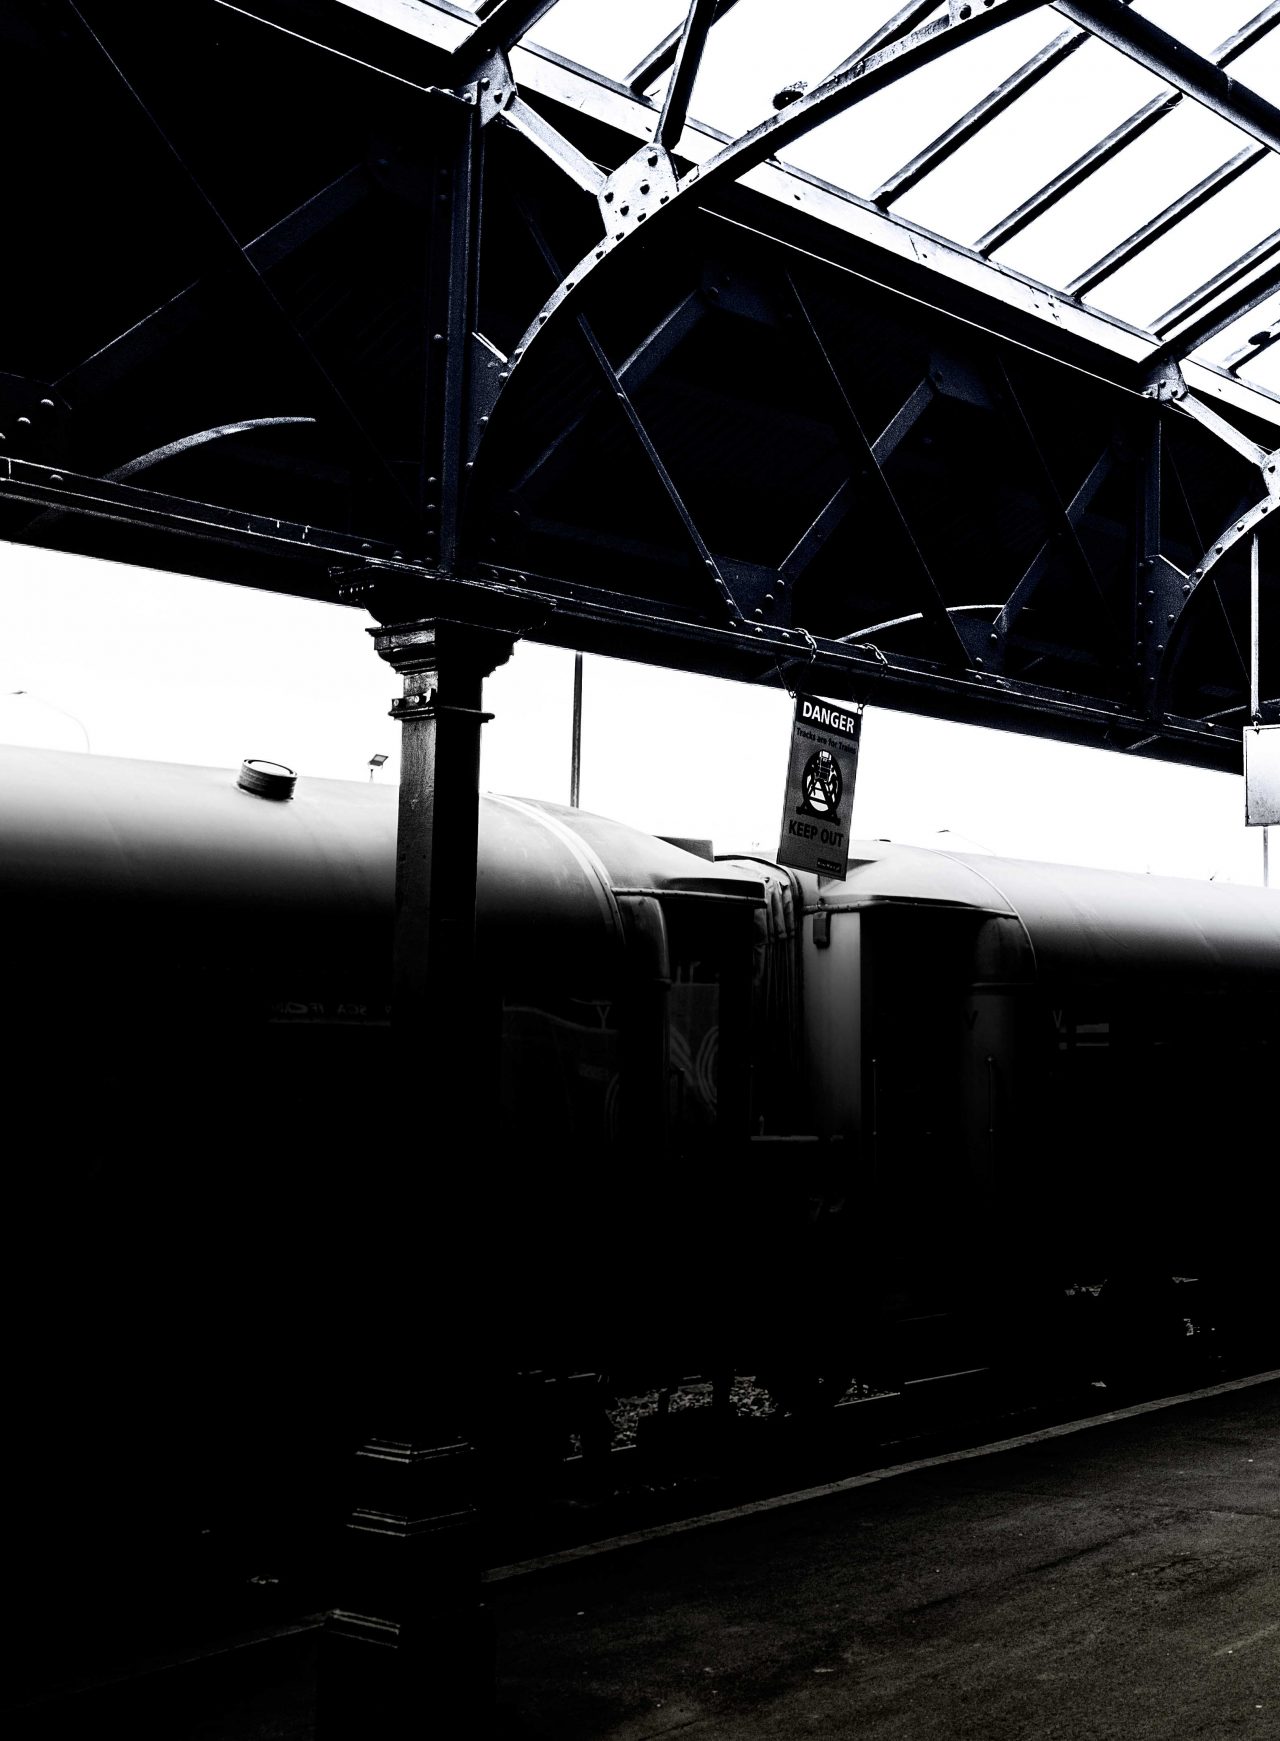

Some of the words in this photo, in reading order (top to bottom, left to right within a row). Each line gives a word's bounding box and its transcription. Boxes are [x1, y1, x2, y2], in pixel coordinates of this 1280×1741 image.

[802, 701, 855, 733] DANGER
[788, 819, 818, 840] KEEP
[820, 828, 844, 847] OUT
